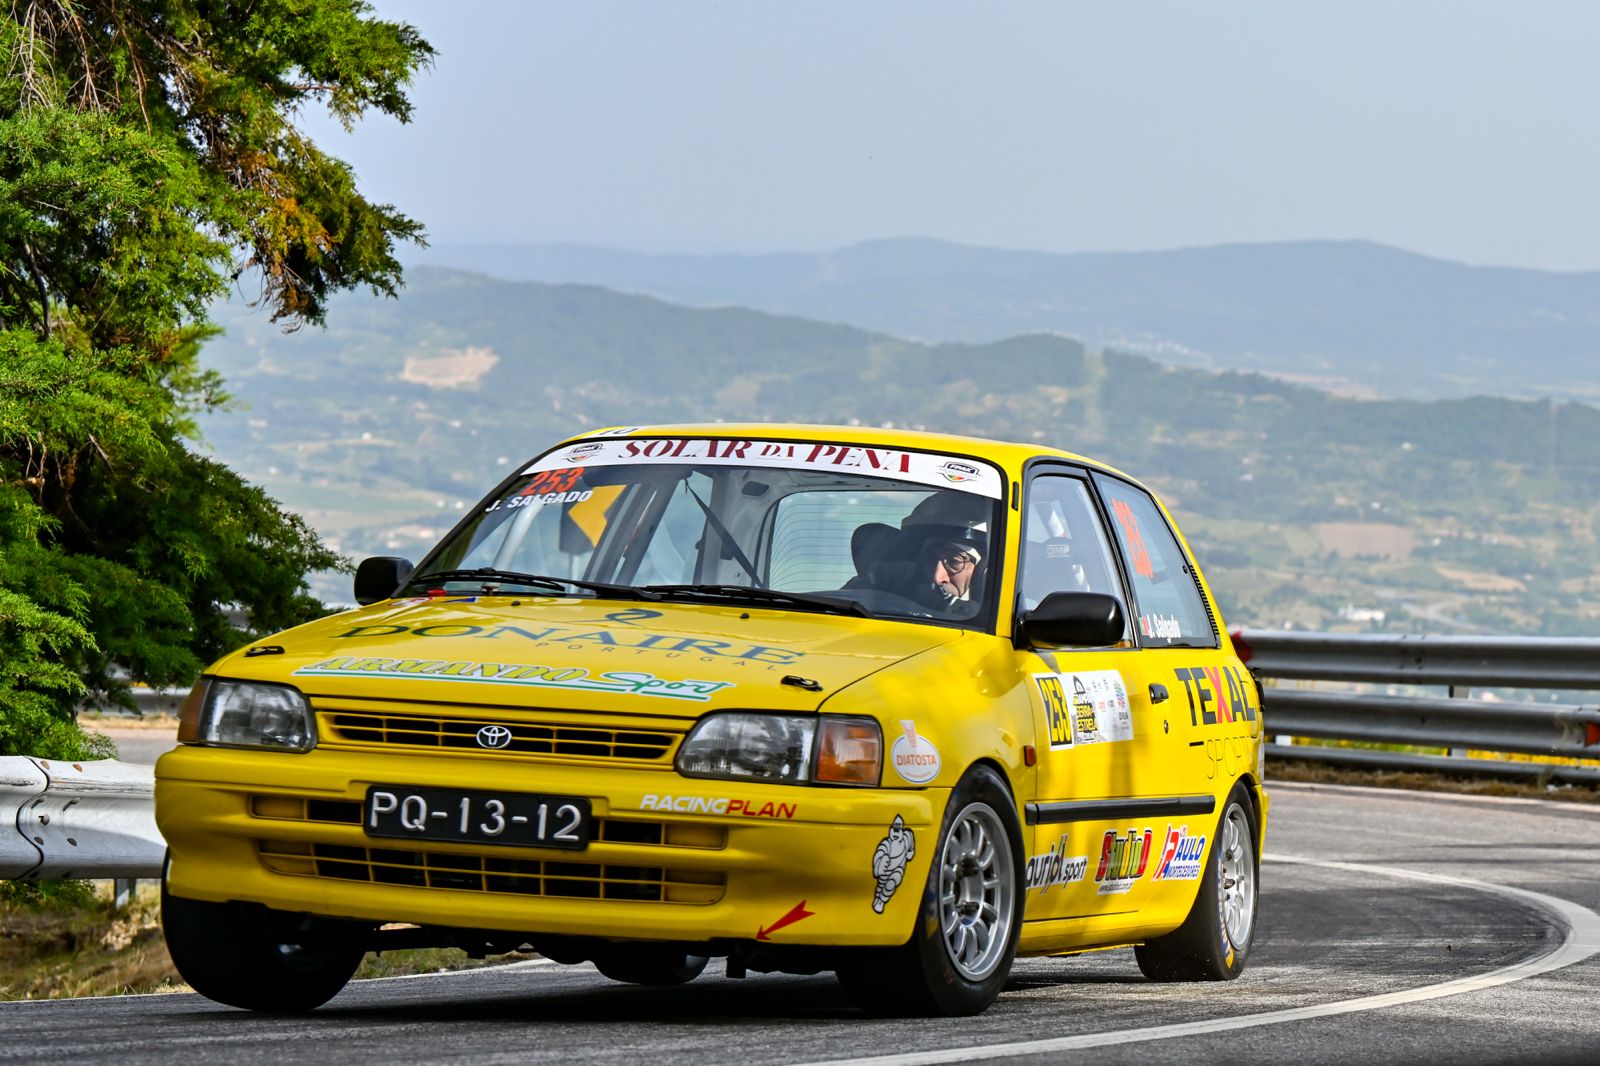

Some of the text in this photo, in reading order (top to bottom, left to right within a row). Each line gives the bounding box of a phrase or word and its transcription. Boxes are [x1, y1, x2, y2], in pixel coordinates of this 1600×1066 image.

[618, 439, 910, 473] SOLAR DA PENA
[520, 467, 585, 497] 253
[485, 490, 594, 513] J. SALGADO
[328, 624, 804, 665] DONAIRE
[534, 642, 778, 672] PORTUGAL
[303, 657, 588, 682] ARMANDO
[1174, 666, 1256, 726] TEXAL
[896, 754, 938, 767] DIATOSTA
[370, 791, 582, 841] PQ-13-12
[1062, 858, 1088, 889] sport
